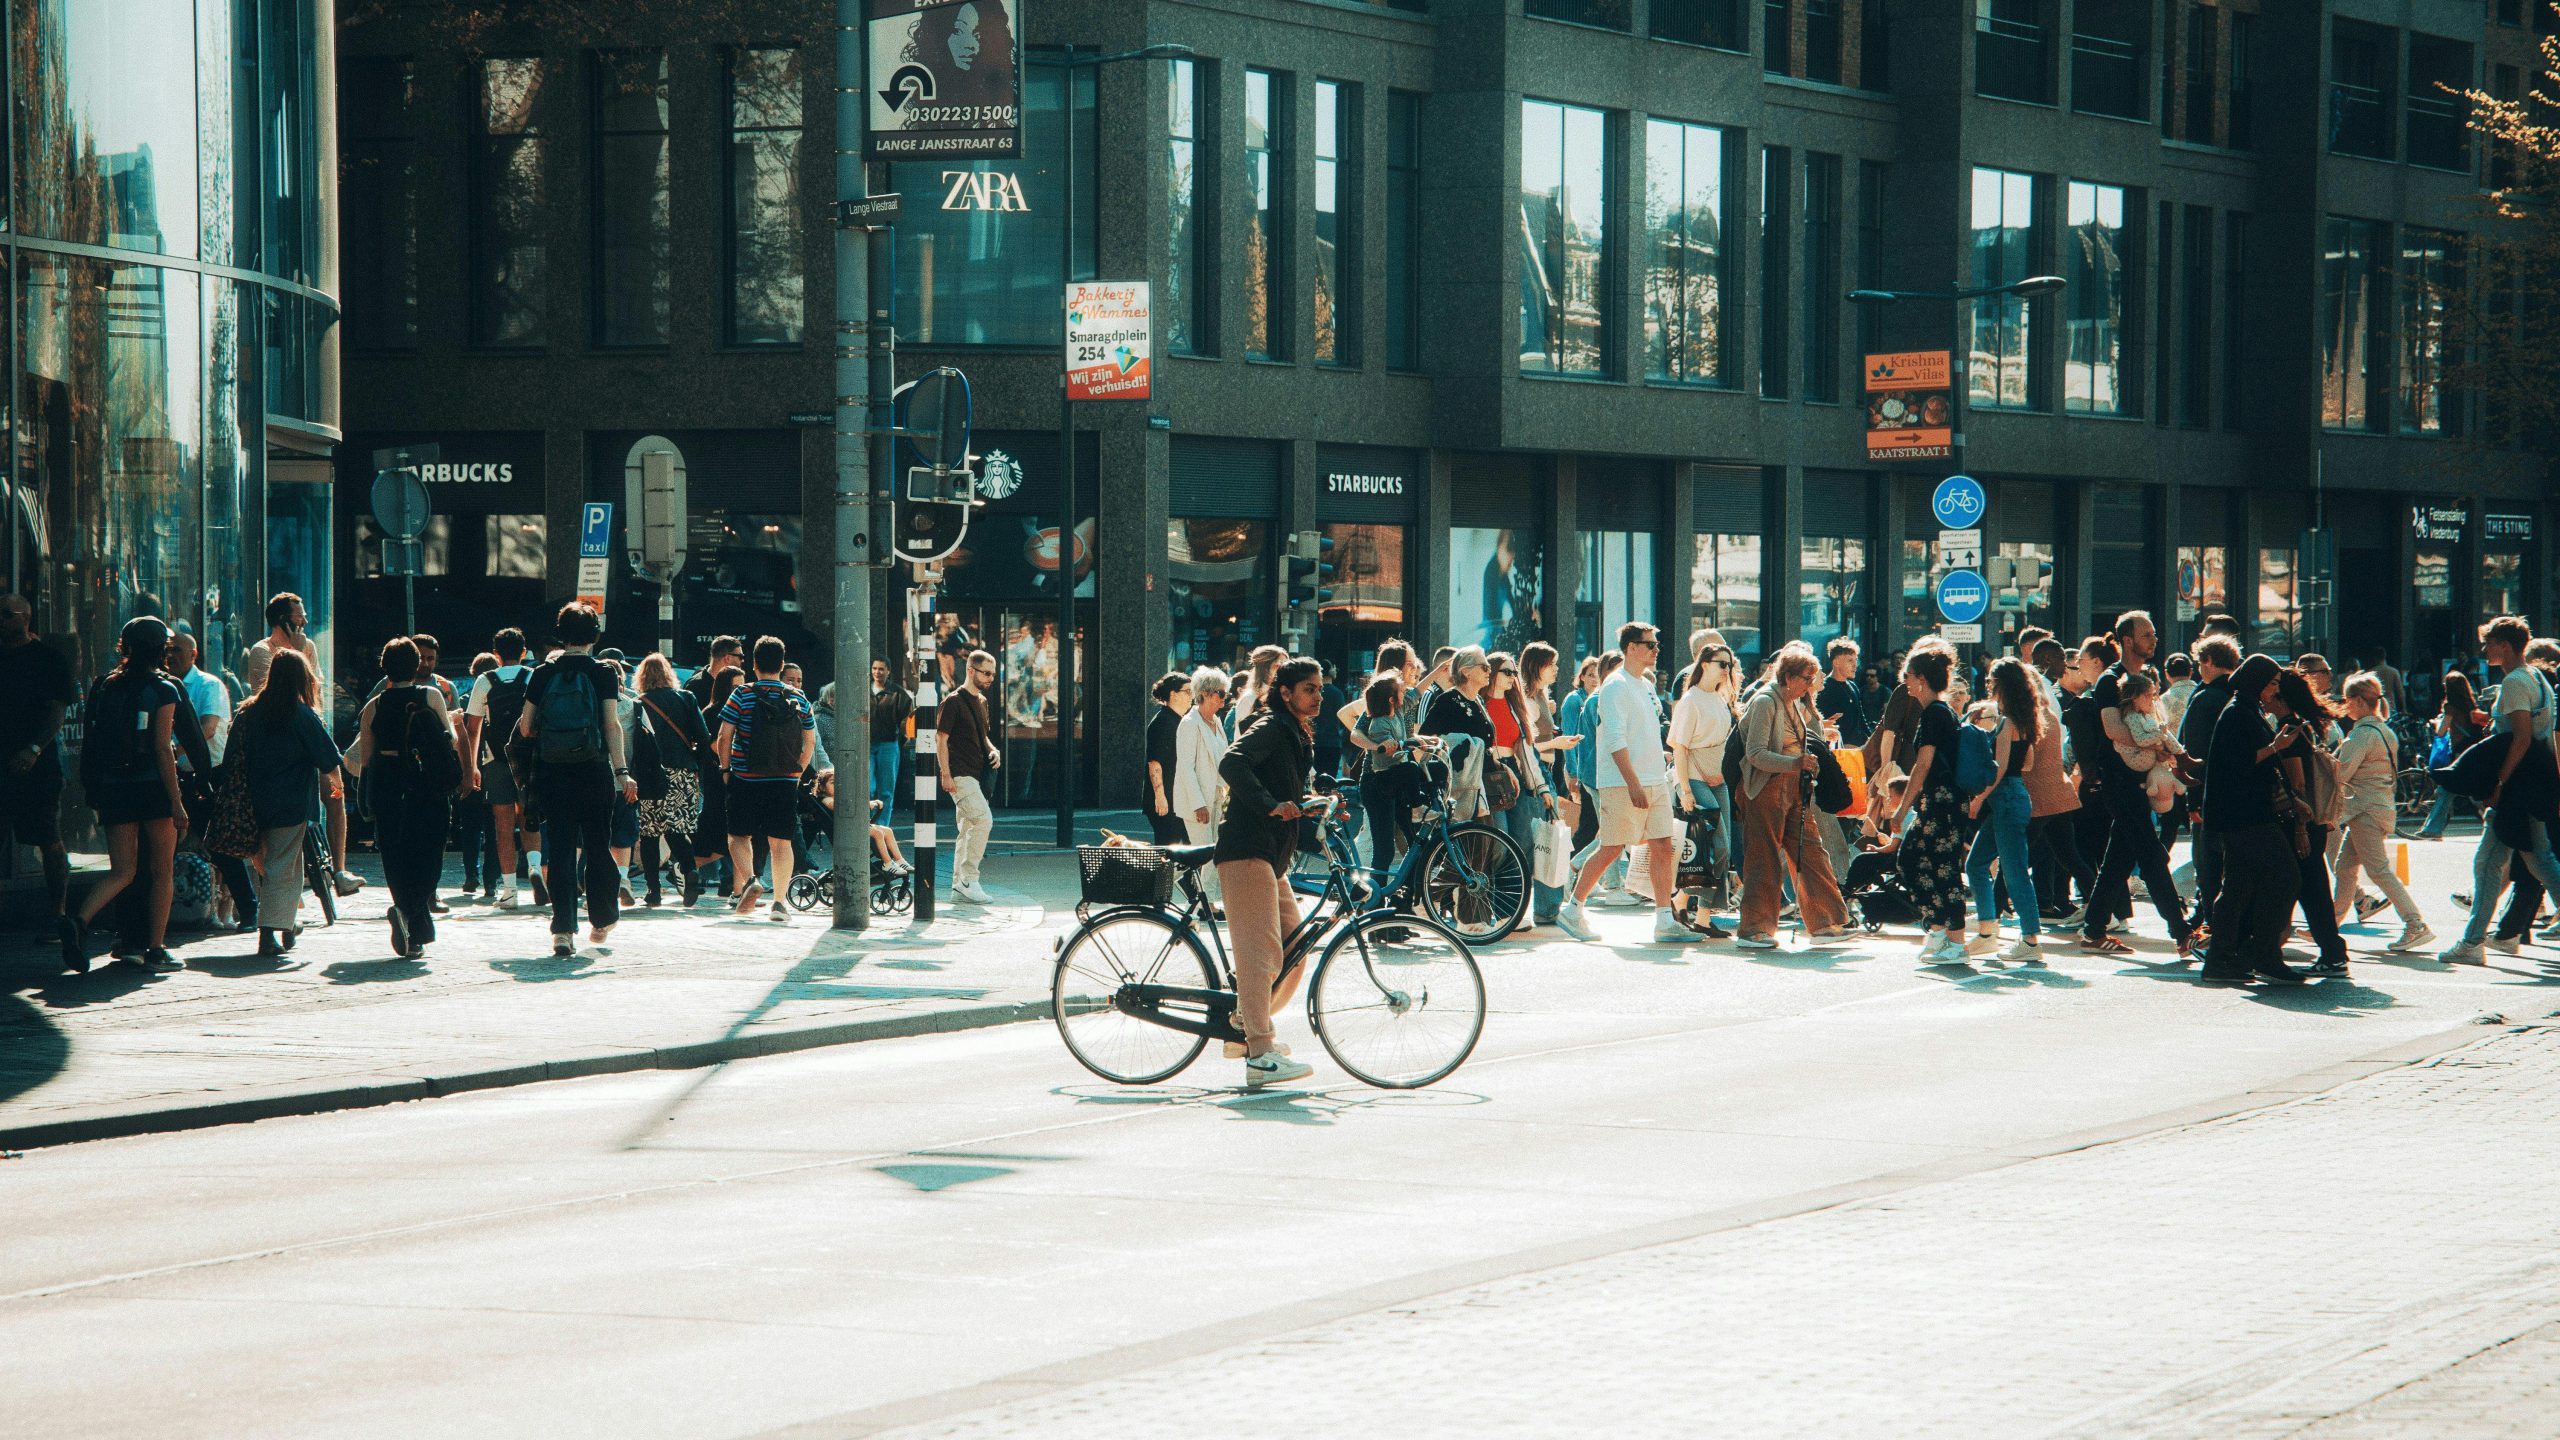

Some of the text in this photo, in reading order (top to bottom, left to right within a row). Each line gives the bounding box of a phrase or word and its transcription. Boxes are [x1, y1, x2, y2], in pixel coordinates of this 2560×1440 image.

[909, 105, 1013, 122] 0302231500
[876, 137, 1013, 151] LANGE JANSSTRAAT 63
[941, 171, 1031, 212] ZARA
[848, 199, 898, 216] Lange Viestraat
[1069, 287, 1135, 310] Bakkerij
[1082, 304, 1148, 320] Wammes
[1069, 330, 1147, 344] Smaragdplein
[1078, 346, 1106, 361] 254
[1891, 354, 1944, 368] Krishna
[1070, 368, 1113, 385] Wij zijn
[1913, 368, 1945, 380] Vilas
[1088, 374, 1148, 395] verhuisd!!
[1870, 446, 1950, 459] KAATSTRAAT 1
[1328, 473, 1403, 494] STARBUCKS
[588, 507, 605, 534] P
[2487, 520, 2530, 533] THE STING
[584, 541, 605, 552] taxi
